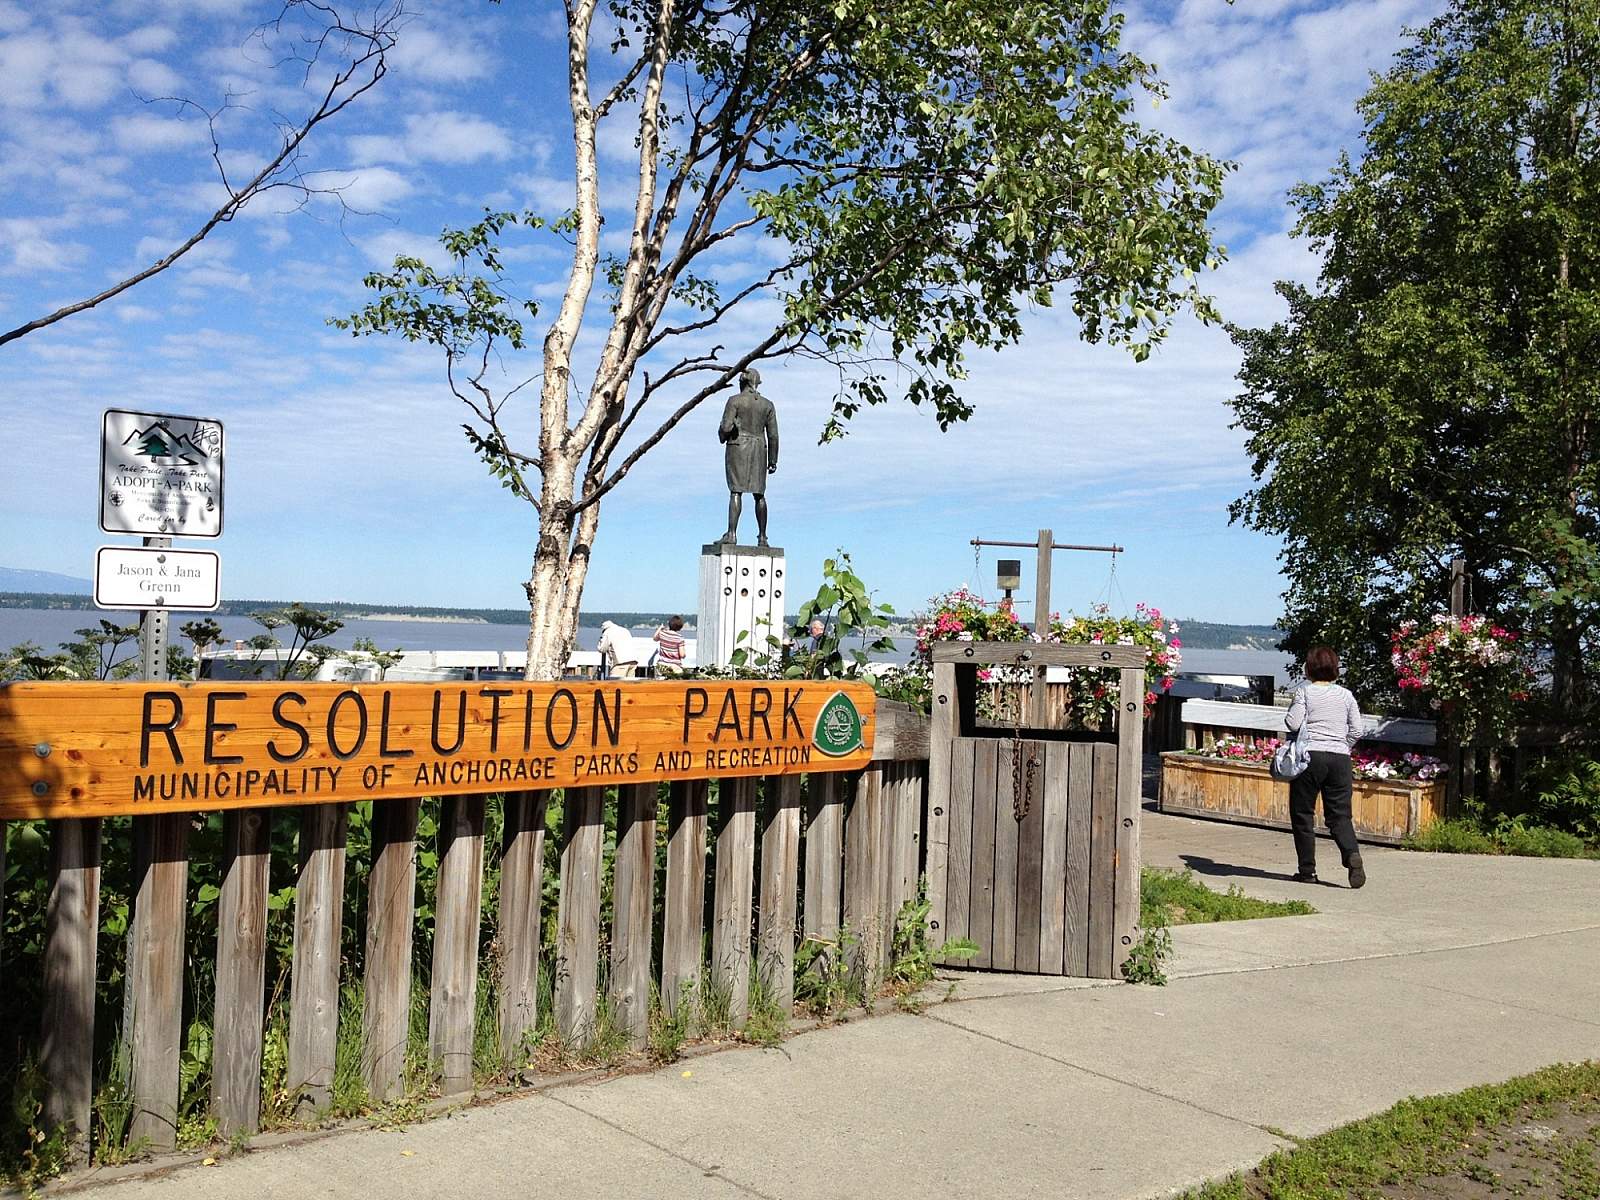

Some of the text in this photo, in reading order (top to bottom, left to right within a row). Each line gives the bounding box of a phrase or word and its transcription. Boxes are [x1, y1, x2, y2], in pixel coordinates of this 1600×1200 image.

[119, 464, 138, 473] Take
[140, 465, 162, 474] Pride
[189, 470, 208, 478] Part
[112, 476, 211, 492] ADOPT-A-PARK
[117, 564, 201, 578] Jason & Jana
[139, 580, 181, 593] Grenn
[139, 688, 622, 768] RESOLUTION
[683, 687, 804, 745] PARK
[133, 745, 811, 803] MUNICIPALITY OF ANCHORAGE PARKS AND RECREATION
